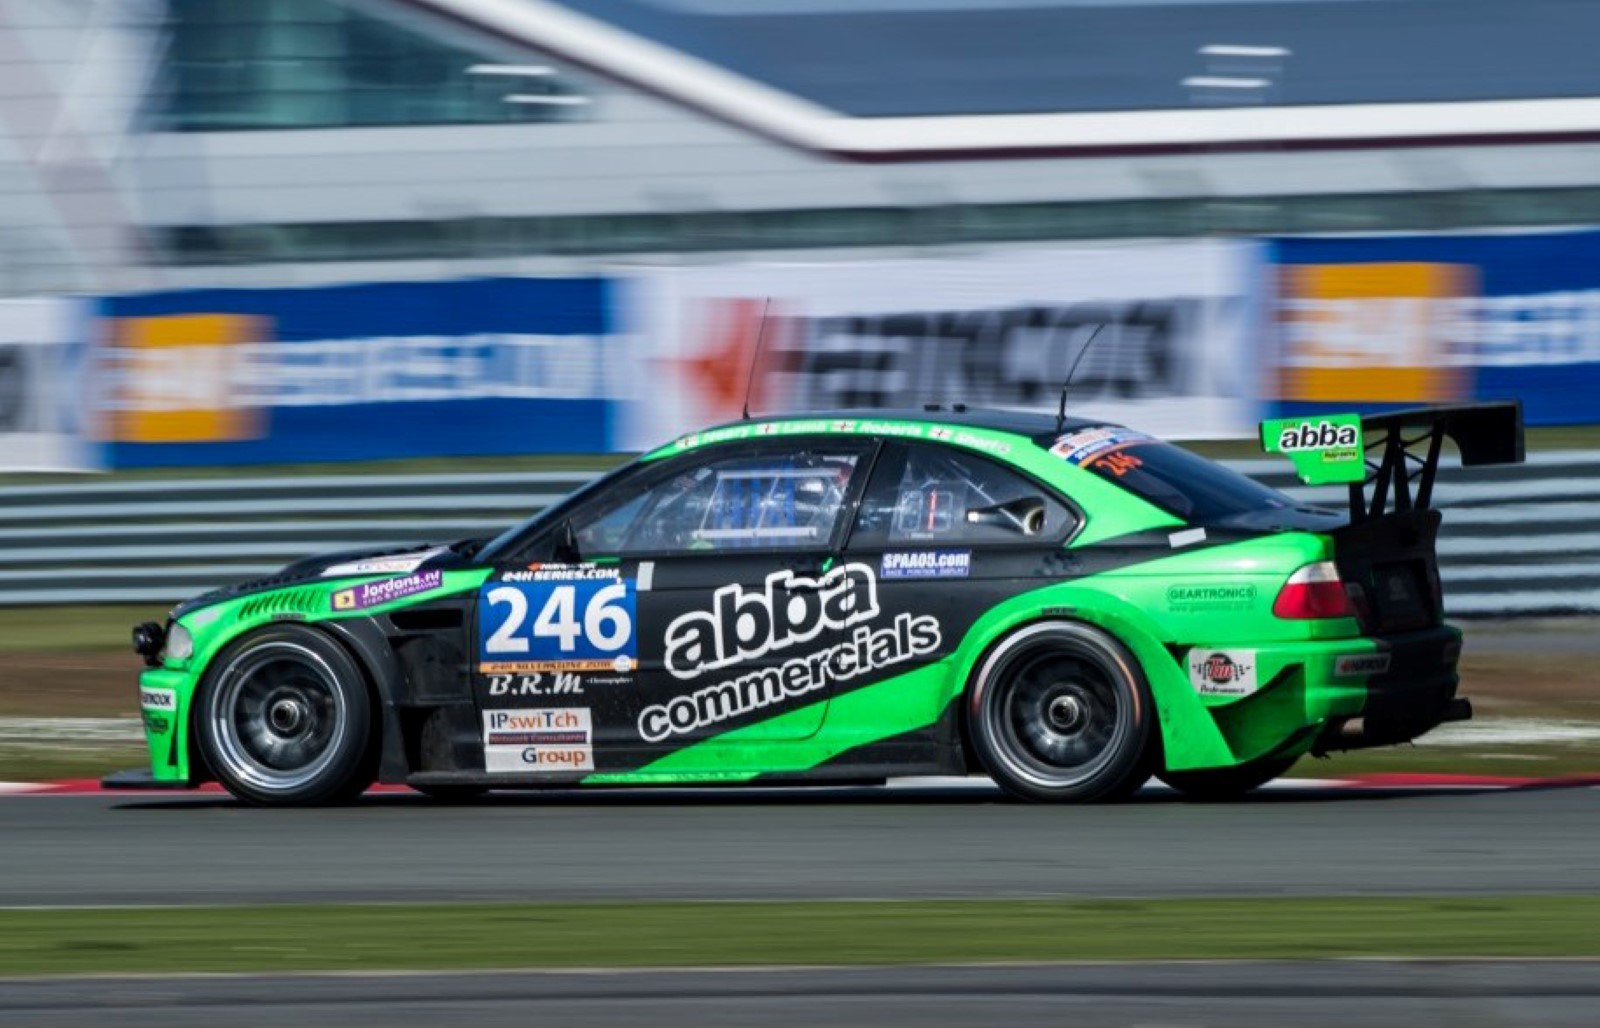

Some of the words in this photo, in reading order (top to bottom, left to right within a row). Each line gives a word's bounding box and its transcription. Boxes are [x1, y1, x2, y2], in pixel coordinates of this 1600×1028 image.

[1279, 421, 1357, 451] abba
[1169, 588, 1254, 599] GEARTRONICS
[485, 585, 632, 653] 246
[664, 562, 880, 679] abba
[638, 613, 941, 742] commercials
[490, 711, 578, 729] IPswiTch
[522, 747, 586, 766] Group
